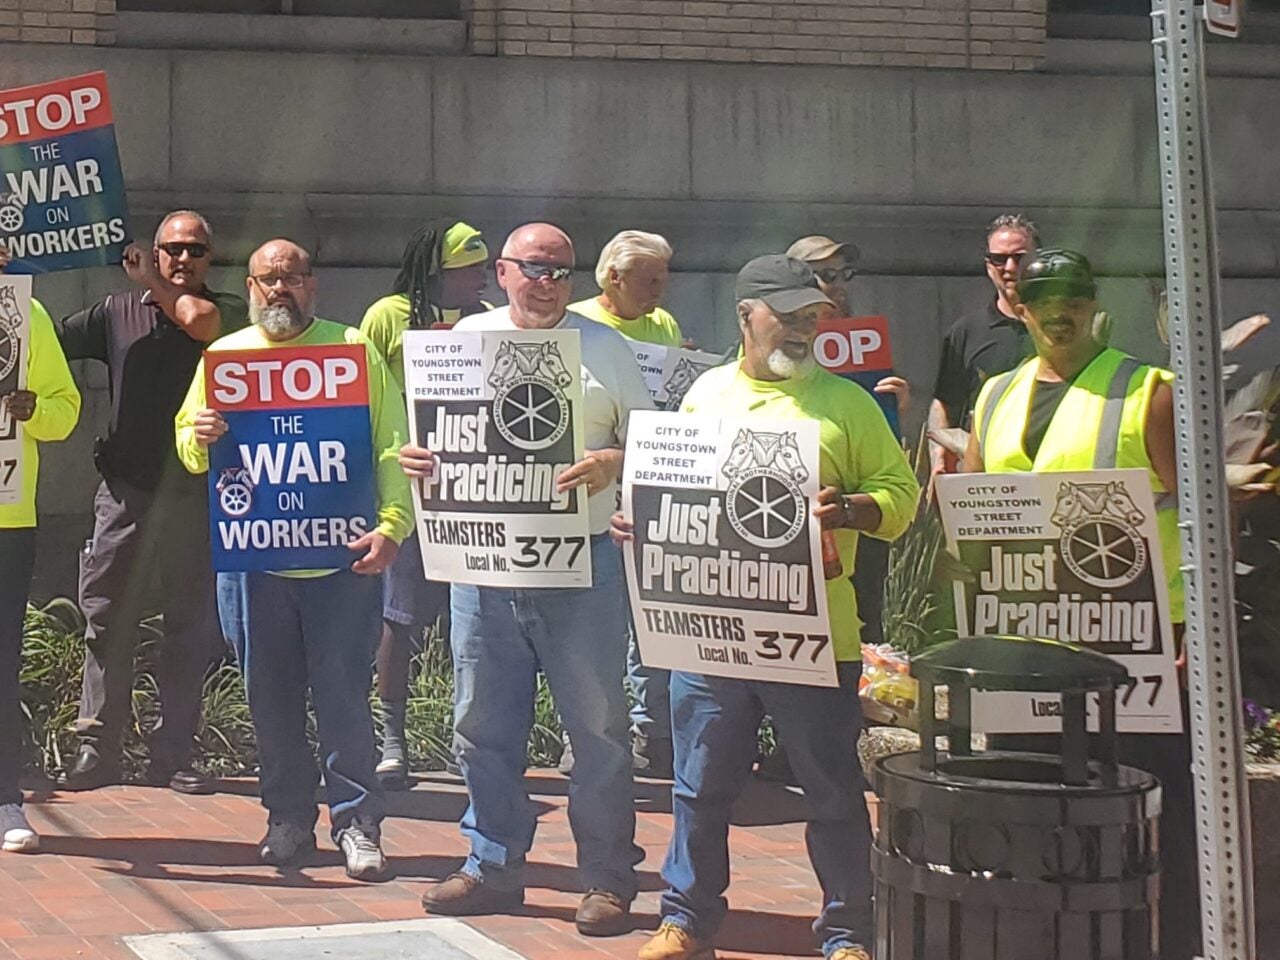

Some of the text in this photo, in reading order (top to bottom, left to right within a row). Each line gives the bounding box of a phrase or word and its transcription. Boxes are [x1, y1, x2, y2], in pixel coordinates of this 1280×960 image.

[30, 142, 61, 162] THE
[6, 158, 103, 206] WAR
[46, 206, 70, 224] ON
[425, 345, 463, 353] CITY OF
[637, 353, 649, 361] OF
[813, 329, 881, 368] OP
[412, 358, 481, 368] YOUNGSTOWN
[213, 358, 358, 404] STOP
[427, 373, 464, 382] STREET
[415, 387, 480, 396] DEPARTMENT
[270, 415, 304, 435] THE
[427, 406, 490, 453] Just
[655, 427, 700, 438] CITY OF
[636, 440, 717, 454] YOUNGSTOWN
[239, 440, 347, 485] WAR
[653, 457, 696, 468] STREET
[423, 455, 571, 511] Practicing
[635, 471, 713, 485] DEPARTMENT
[967, 485, 1018, 495] CITY OF
[278, 491, 304, 511] ON
[949, 497, 1042, 509] YOUNGSTOWN
[647, 493, 721, 546] Just
[973, 512, 1022, 522] STREET
[218, 516, 368, 550] WORKERS
[424, 518, 506, 547] TEAMSTERS
[958, 526, 1043, 537] DEPARTMENT
[465, 536, 585, 572] Local No. 377
[642, 543, 808, 612] Practicing
[980, 545, 1057, 591] Just
[642, 608, 746, 641] TEAMSTERS
[975, 593, 1154, 651] Practicing
[697, 630, 829, 666] Local No. 377
[1031, 698, 1063, 717] Loca
